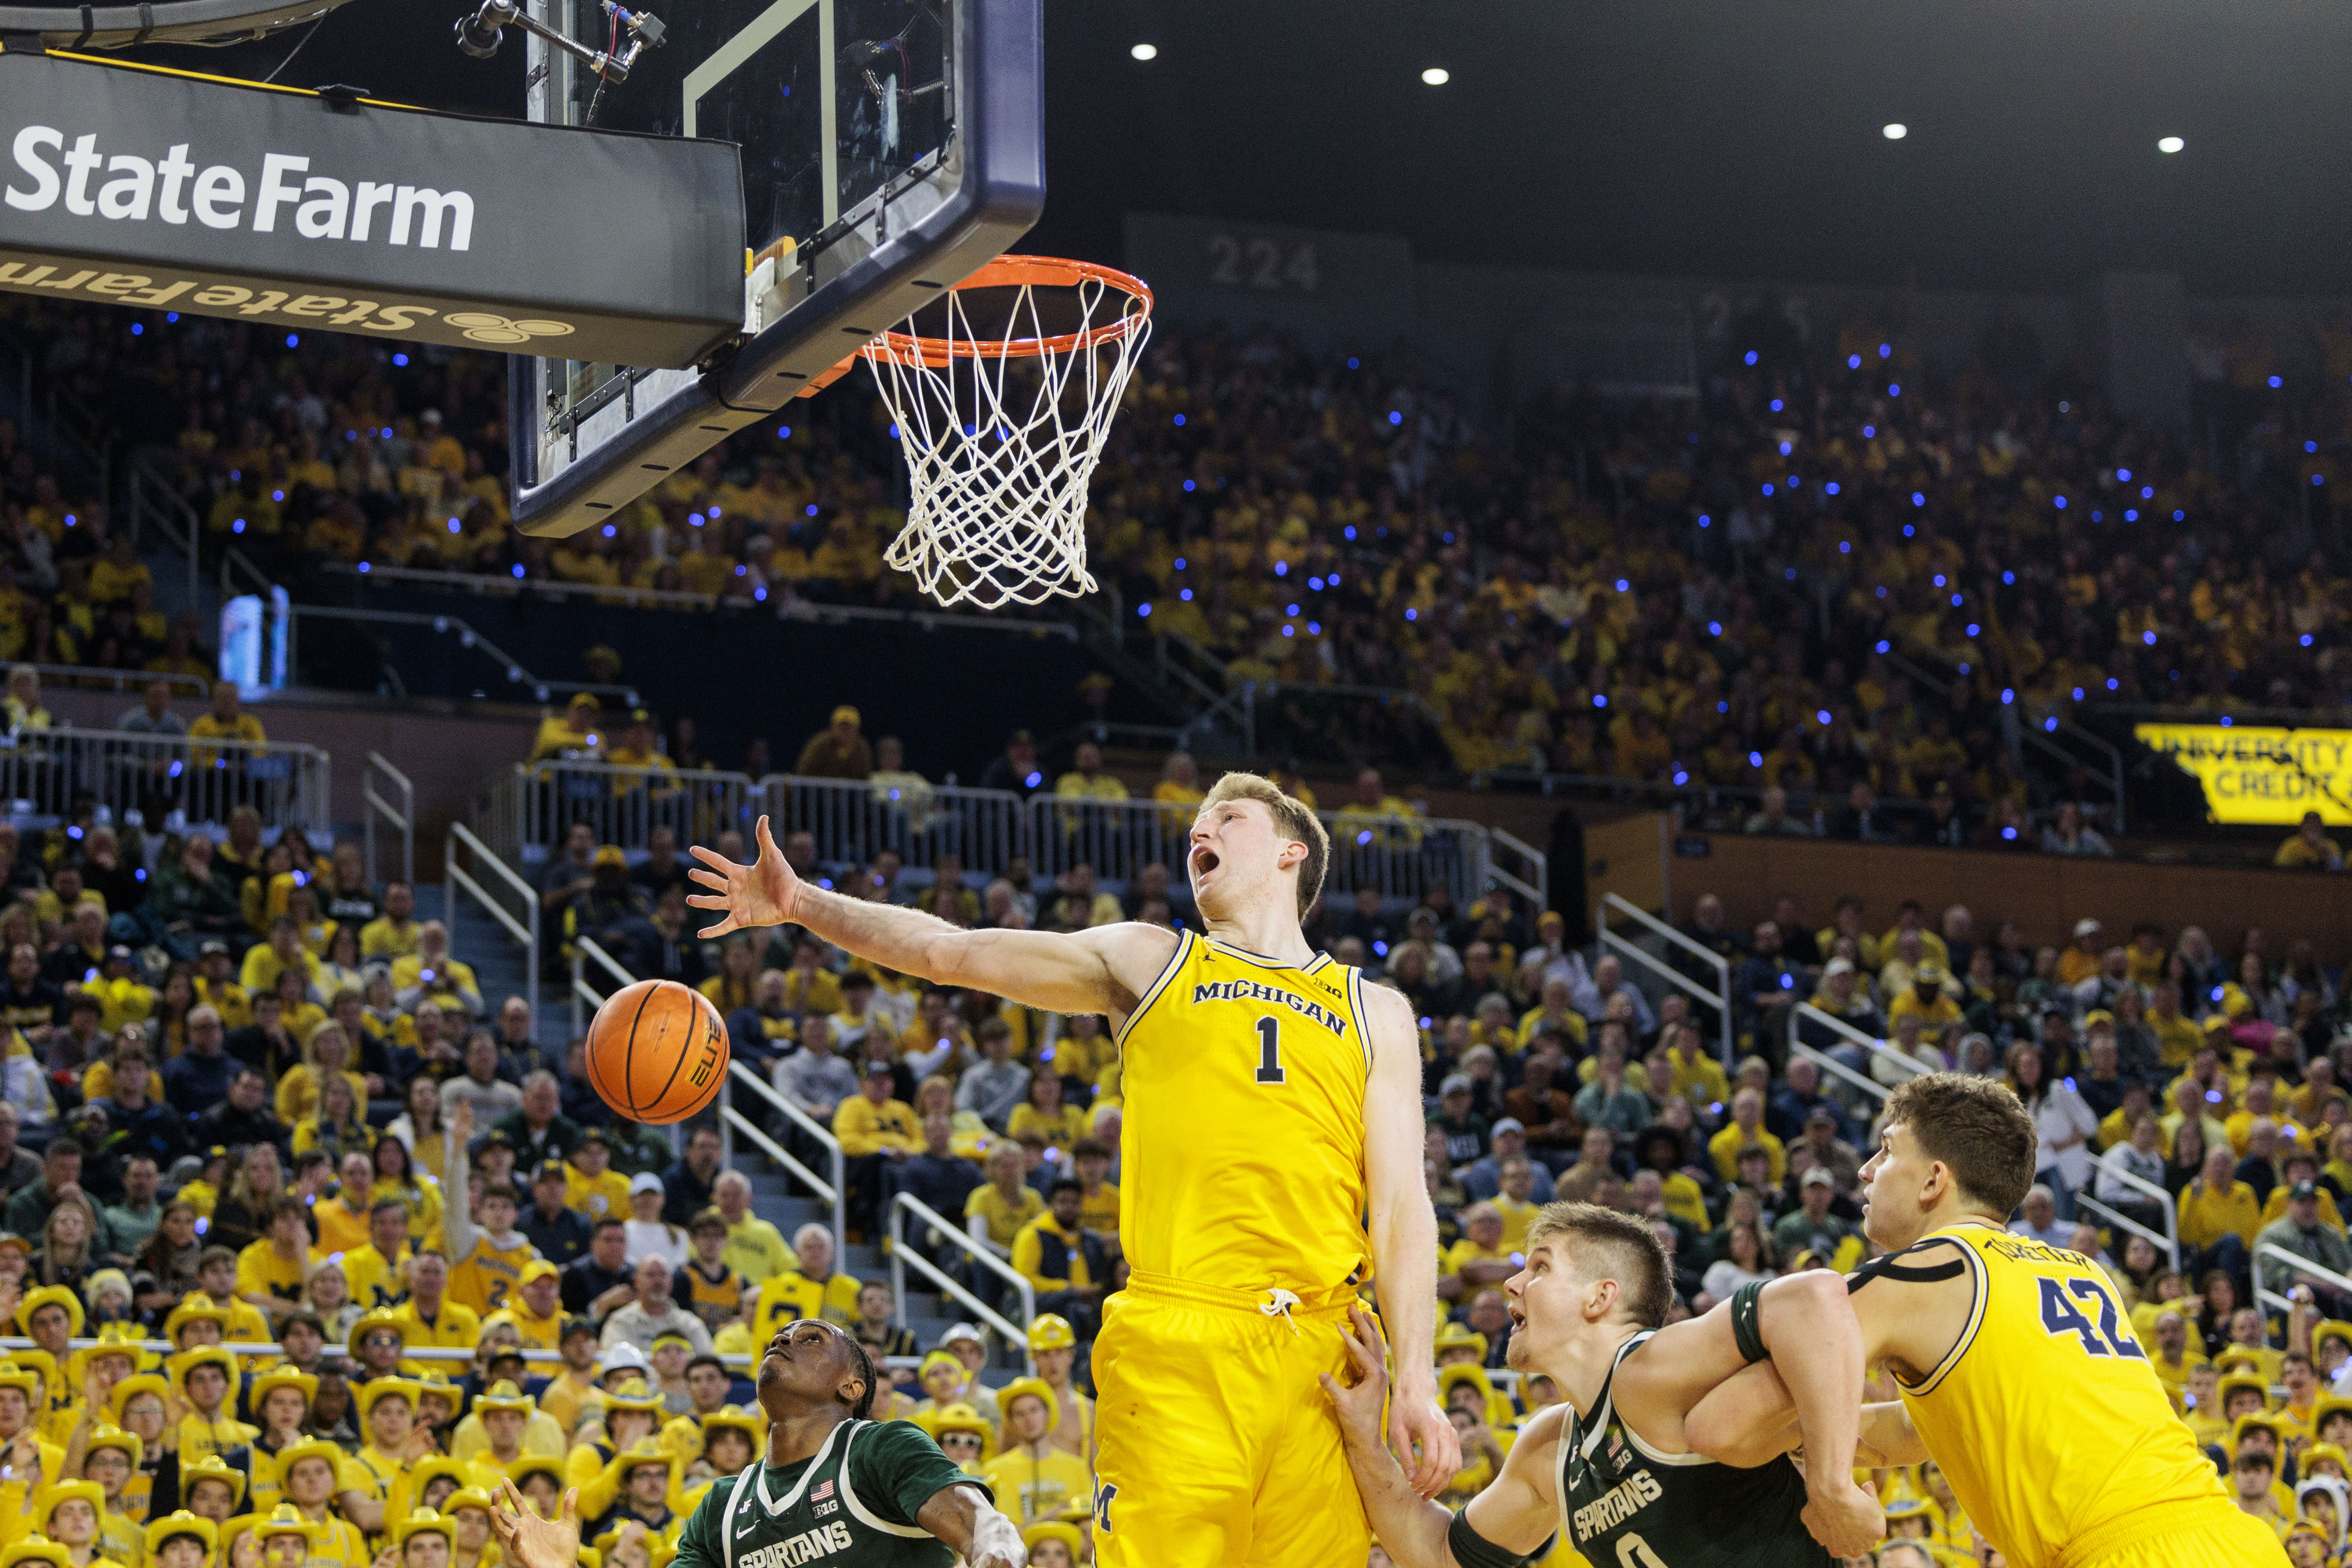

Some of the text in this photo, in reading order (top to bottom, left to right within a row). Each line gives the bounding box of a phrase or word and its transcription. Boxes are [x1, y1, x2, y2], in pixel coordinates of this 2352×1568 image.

[1207, 234, 1319, 292] 224
[1192, 979, 1348, 1040] MICHIGAN
[690, 1015, 722, 1089] ELITE
[1254, 1014, 1286, 1085] 1
[2034, 1275, 2151, 1361] 42
[1091, 1472, 1120, 1534] M
[1573, 1468, 1663, 1544] SPARTANS
[738, 1519, 854, 1568] SPARTANS
